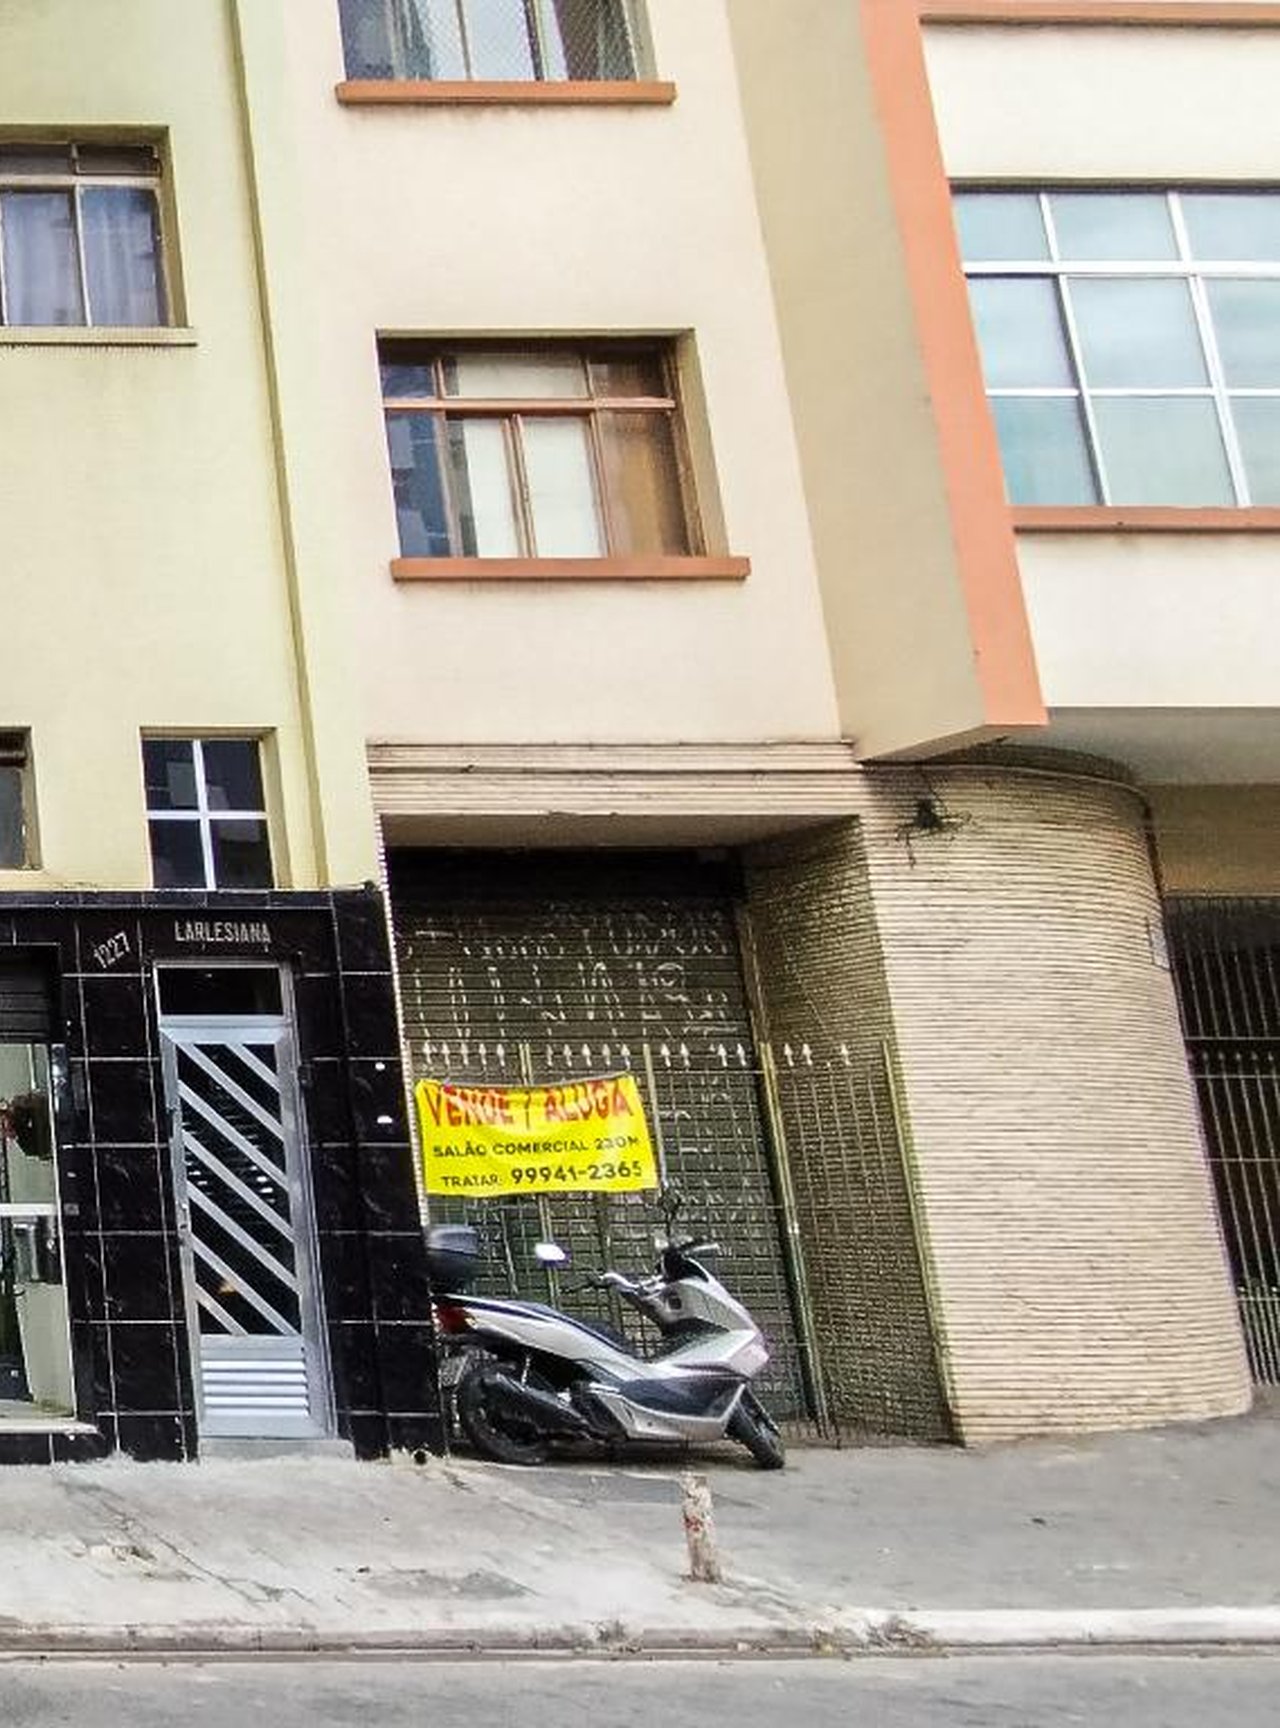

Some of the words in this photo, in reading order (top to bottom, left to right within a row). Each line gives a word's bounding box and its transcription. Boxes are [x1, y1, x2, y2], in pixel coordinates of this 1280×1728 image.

[93, 930, 131, 969] 1227
[543, 1079, 635, 1123] ALUGA
[492, 1138, 590, 1156] COMERCIAL
[510, 1160, 642, 1184] 99941-2365
